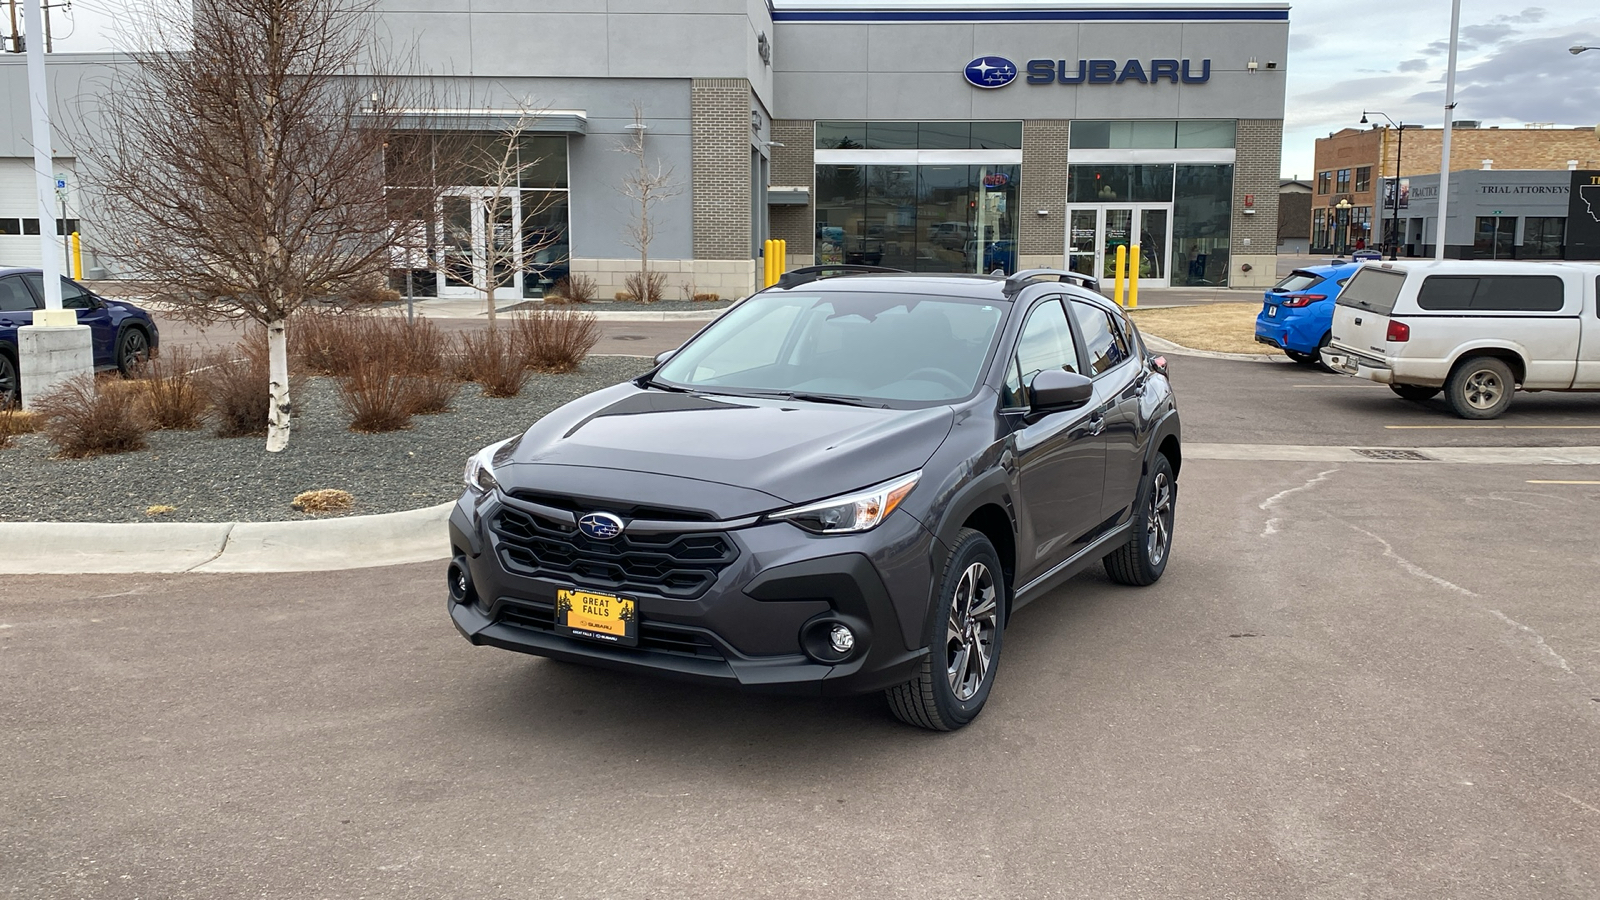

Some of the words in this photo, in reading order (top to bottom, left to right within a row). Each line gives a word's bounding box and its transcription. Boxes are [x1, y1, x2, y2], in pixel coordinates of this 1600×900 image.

[1026, 59, 1211, 84] SUBARU
[1411, 186, 1438, 198] PRACTICE
[1481, 185, 1511, 194] TRIAL
[1513, 185, 1570, 194] ATTORNEYS
[582, 596, 610, 608] GREAT
[582, 605, 610, 617] FALLS
[588, 622, 612, 630] SUBARU
